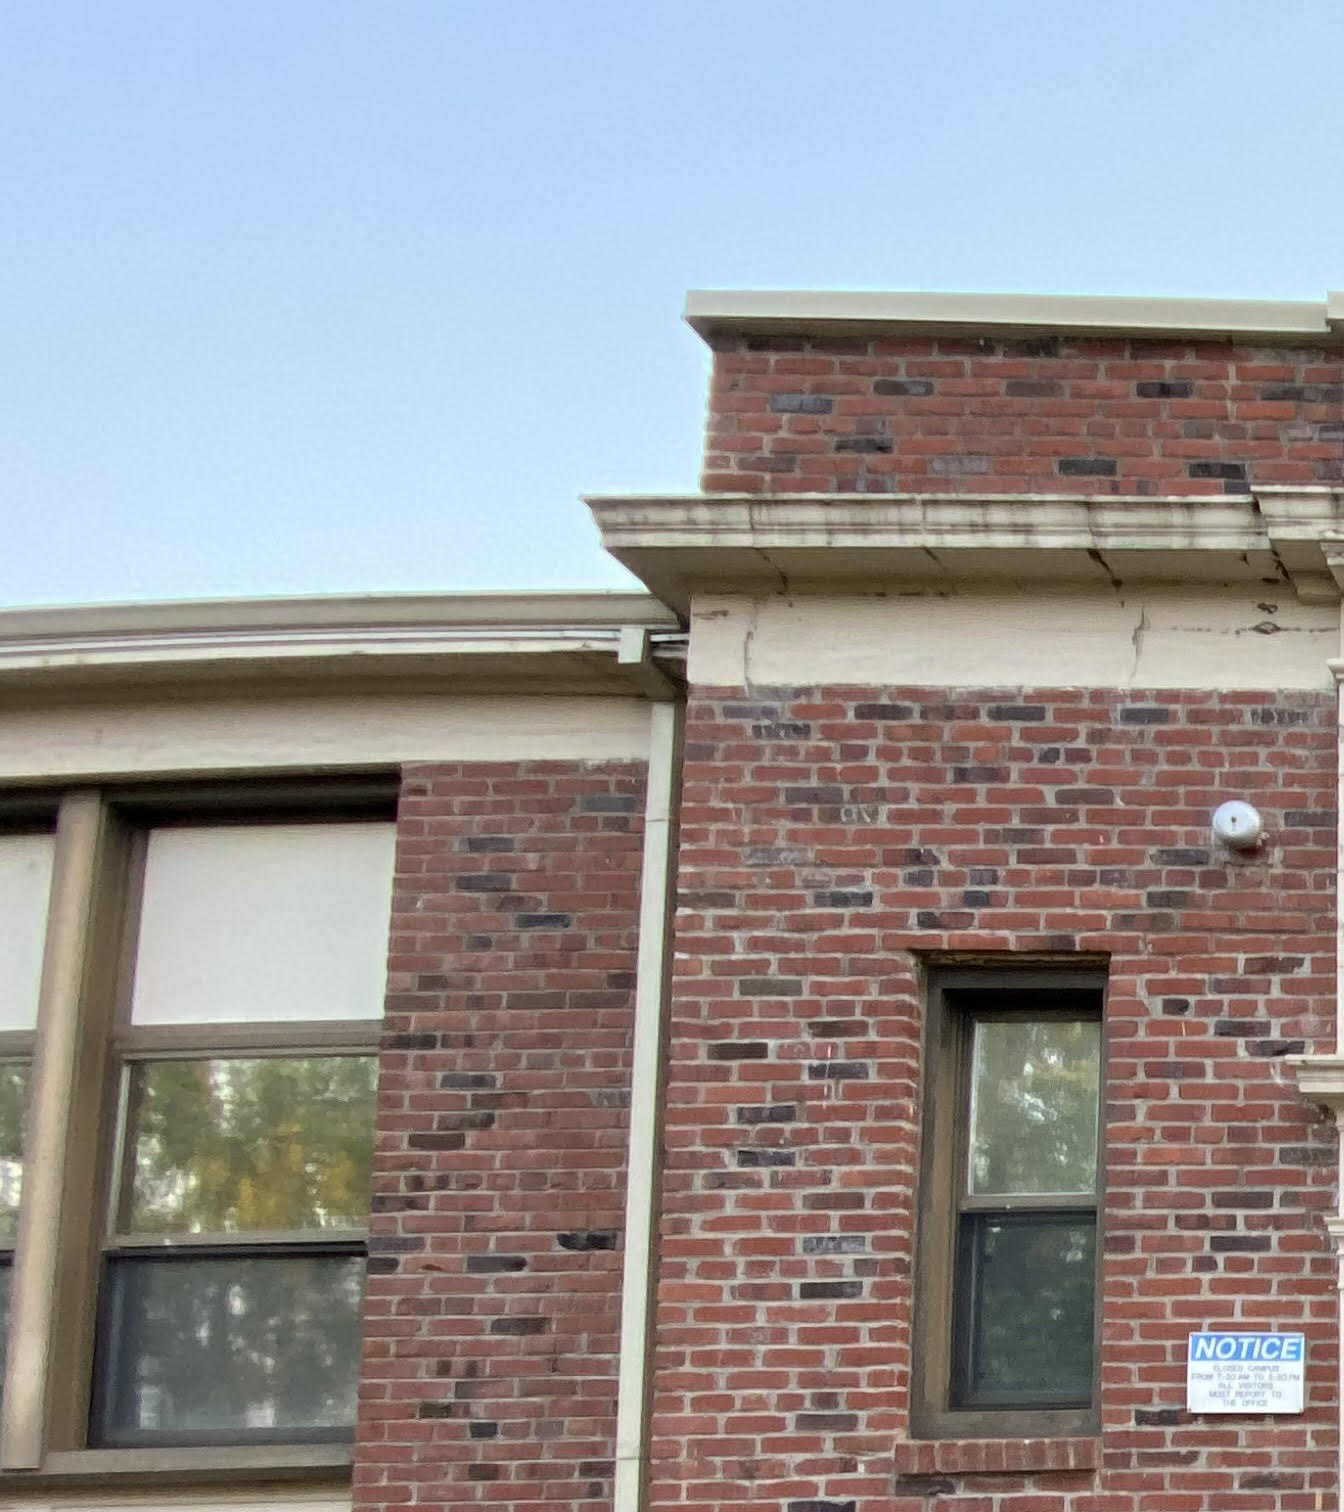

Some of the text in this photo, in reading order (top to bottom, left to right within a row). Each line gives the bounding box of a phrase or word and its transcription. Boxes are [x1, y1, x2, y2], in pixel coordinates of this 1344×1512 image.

[1195, 1336, 1300, 1360] NOTICE
[1213, 1364, 1243, 1372] CLOSED
[1191, 1372, 1213, 1380] FROM
[1208, 1390, 1282, 1398] MUST REPORT TO
[1223, 1399, 1236, 1407] THE
